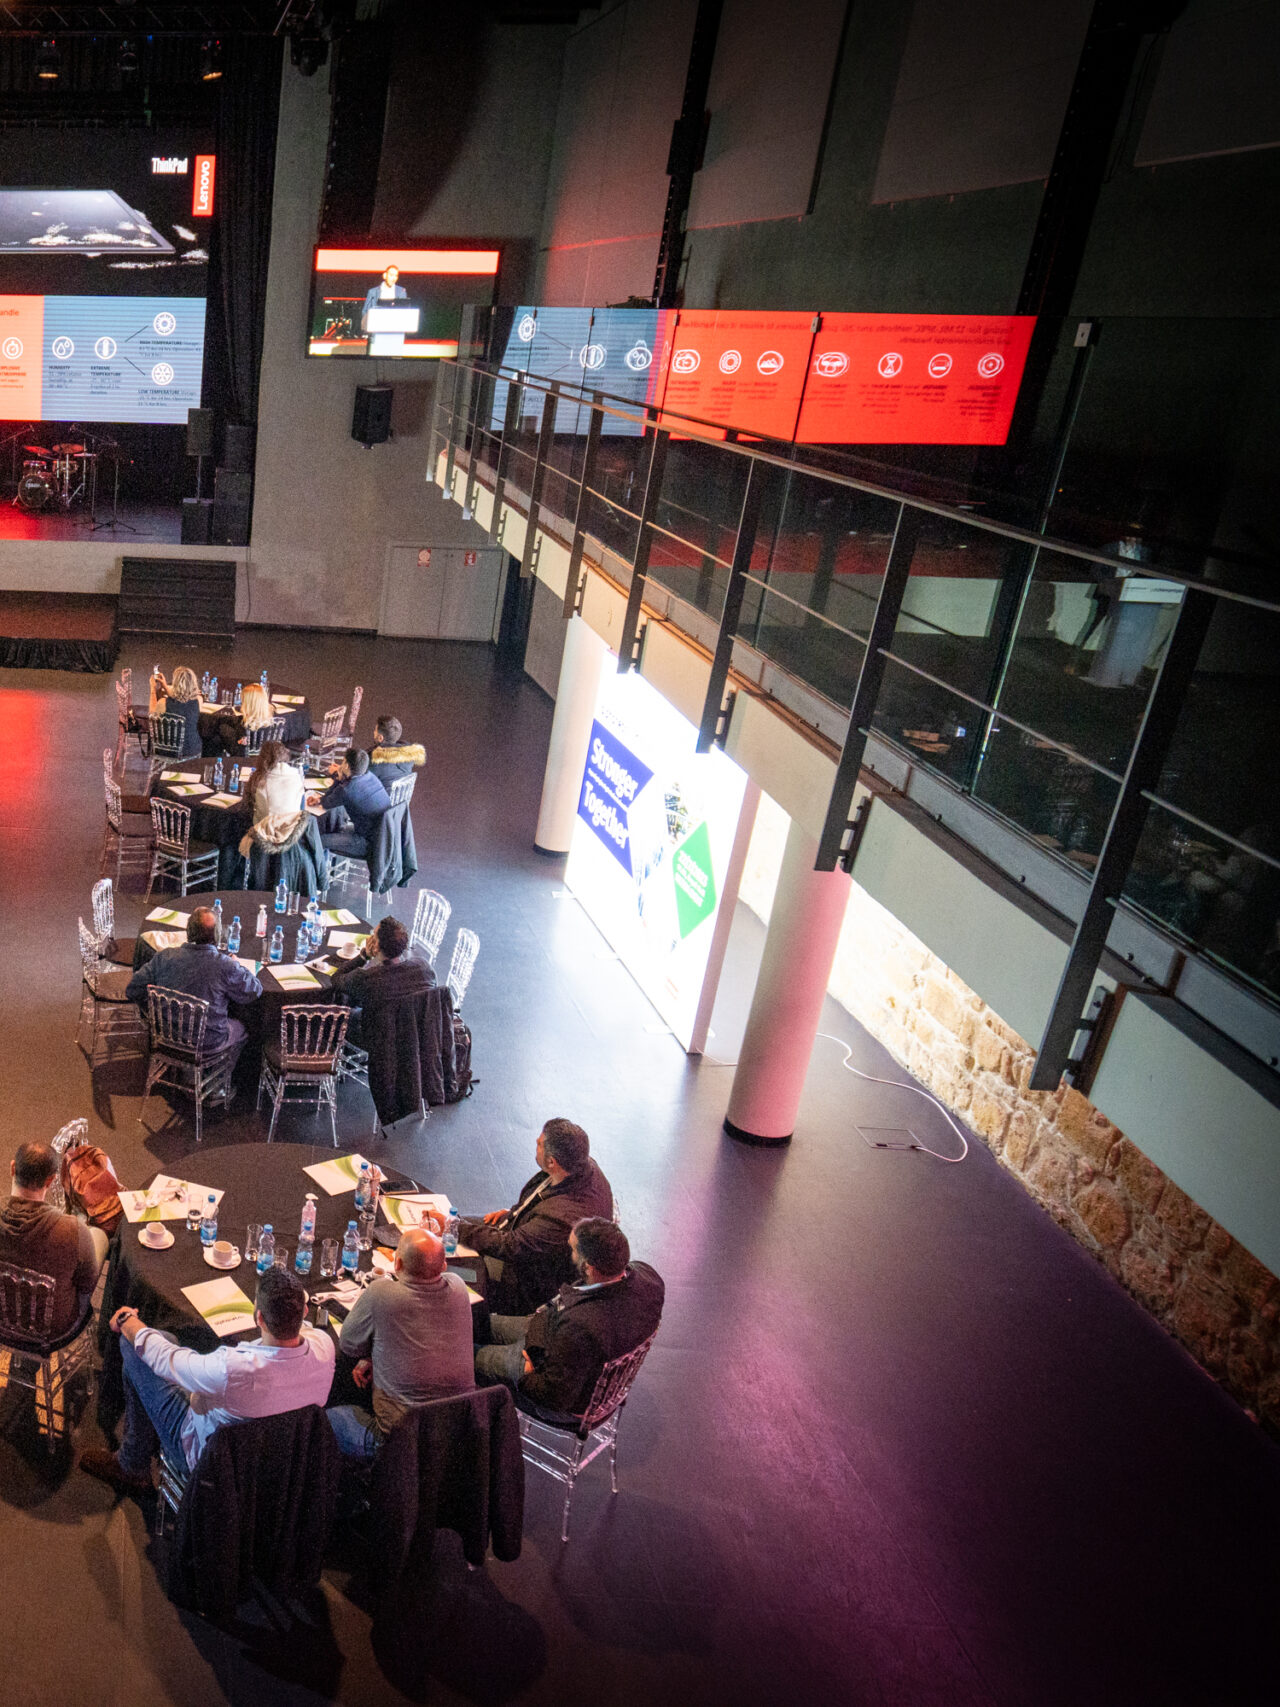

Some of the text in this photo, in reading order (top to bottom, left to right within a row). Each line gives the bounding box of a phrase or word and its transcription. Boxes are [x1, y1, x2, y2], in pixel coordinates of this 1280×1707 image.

[151, 156, 189, 175] ThinkPad
[196, 160, 211, 211] Lenovo
[590, 737, 639, 802] Stronger
[583, 780, 630, 849] Together
